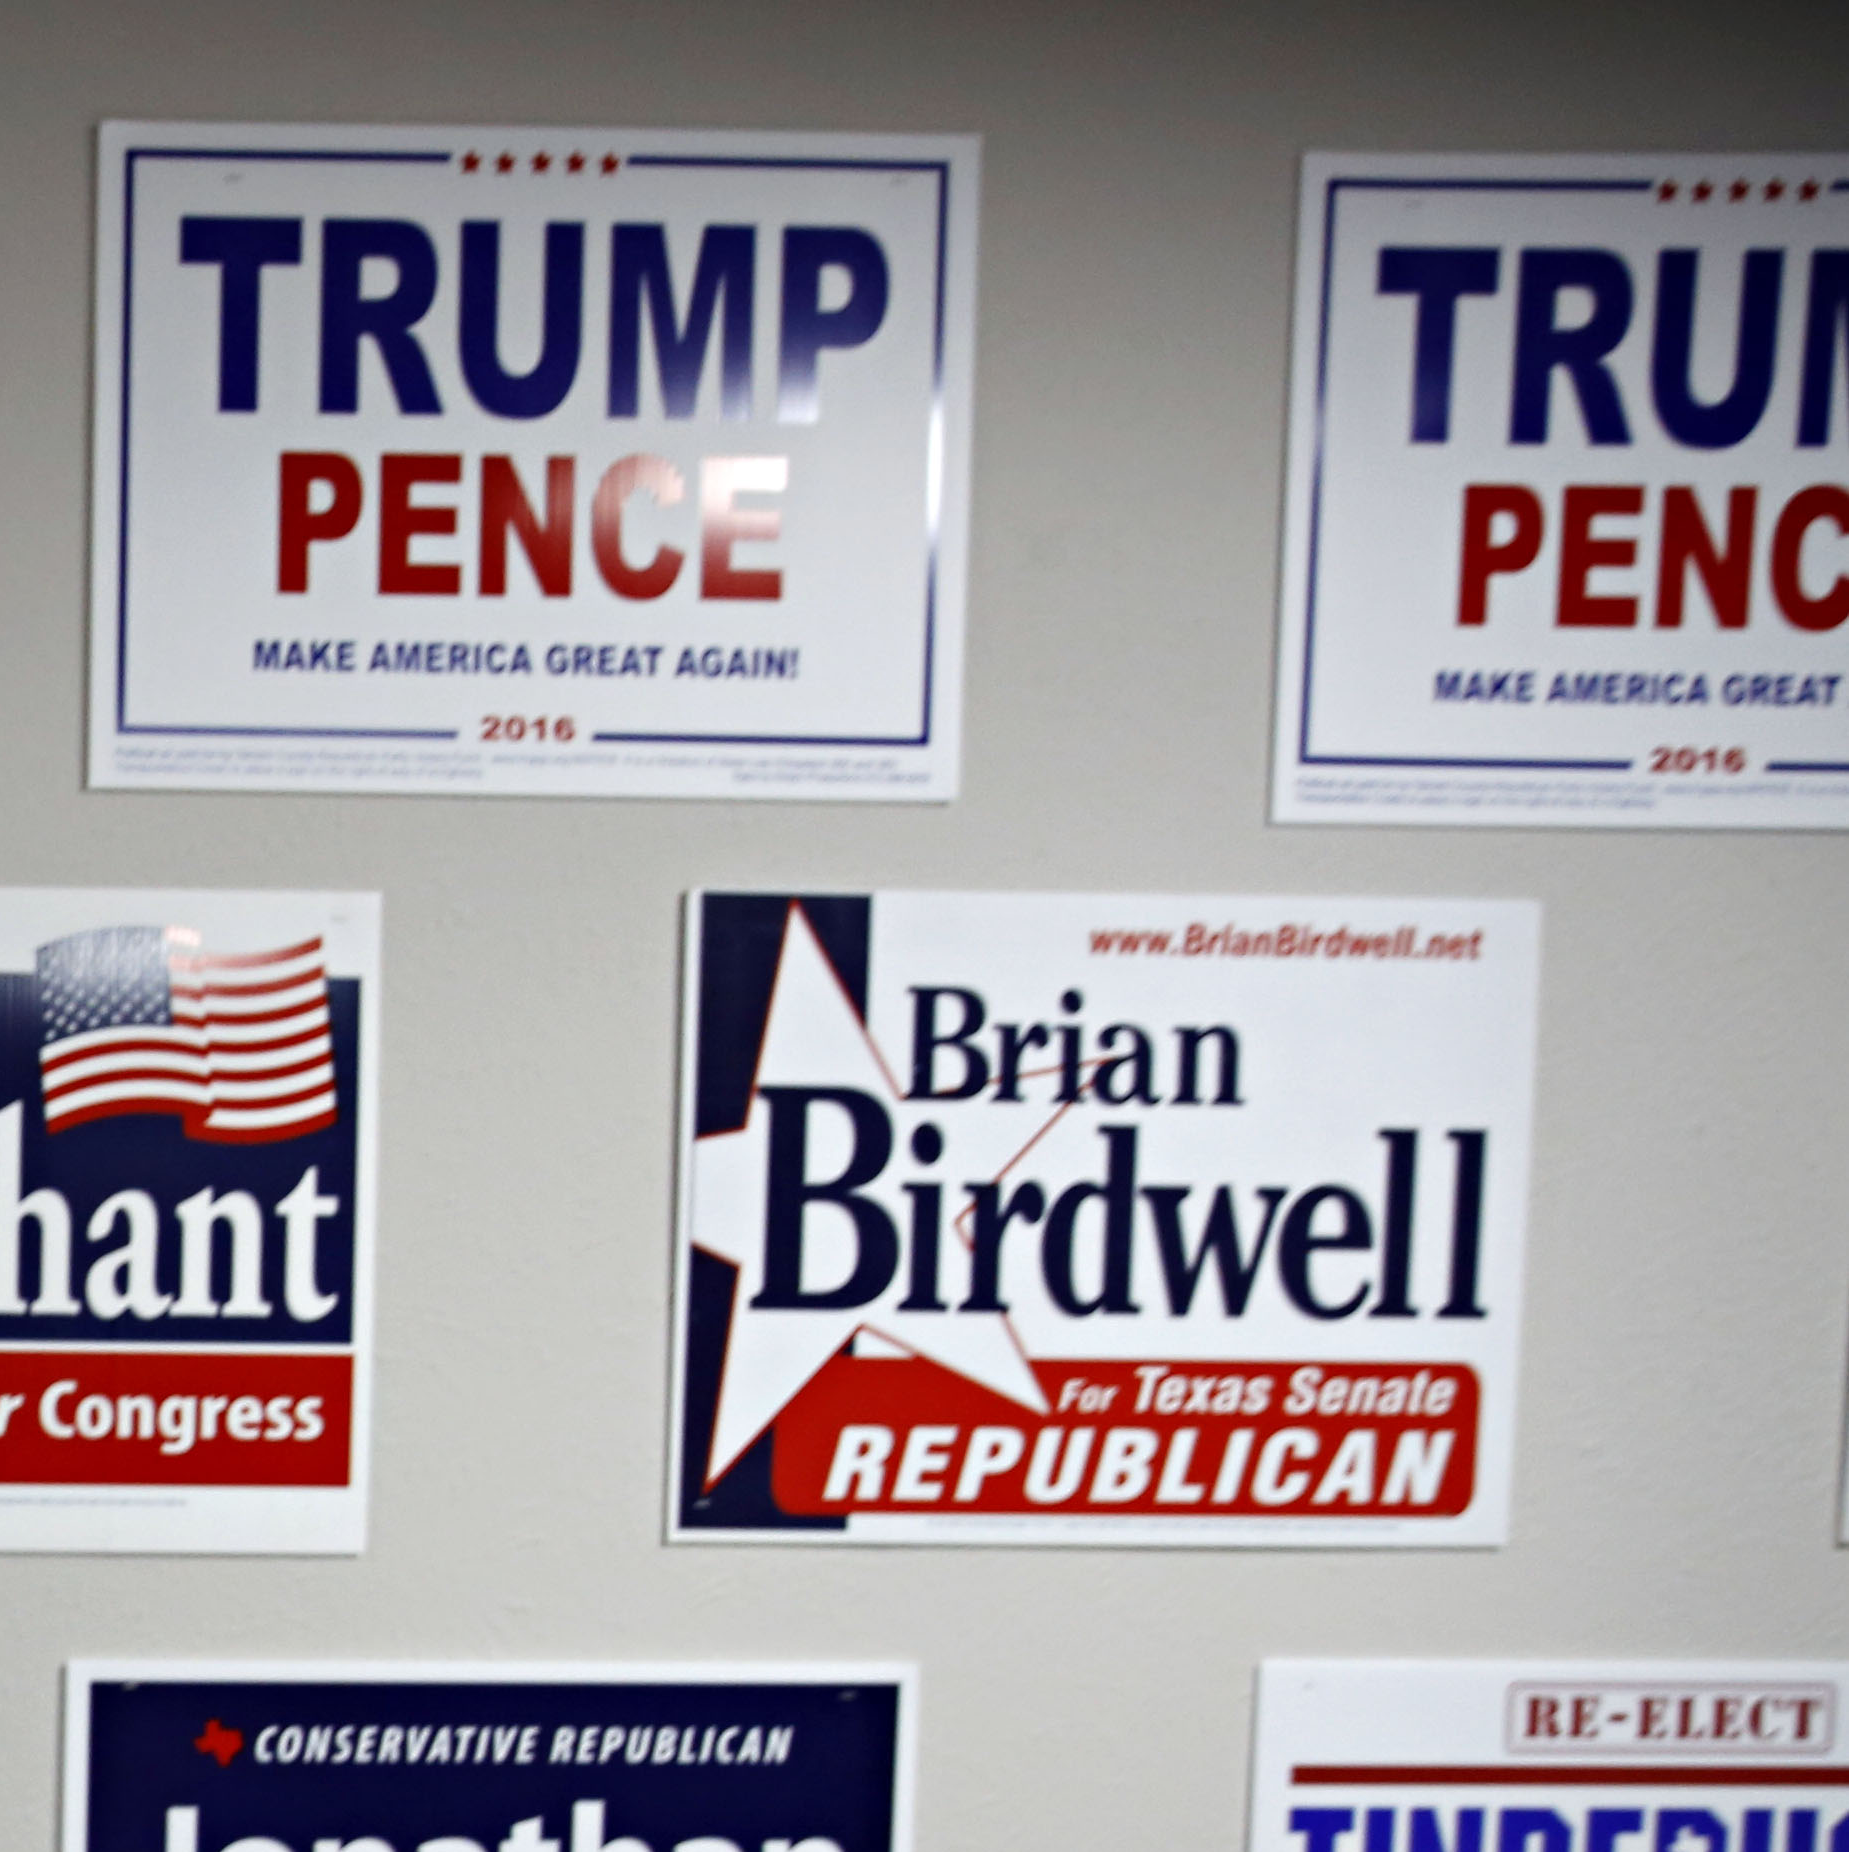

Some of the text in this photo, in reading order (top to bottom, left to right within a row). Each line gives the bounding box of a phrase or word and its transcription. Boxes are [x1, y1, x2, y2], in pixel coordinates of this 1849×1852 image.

[179, 216, 890, 423] TRUMP
[276, 451, 789, 602] PENCE
[254, 640, 798, 679] MAKE AMERICA GREAT AGAIN!
[1435, 671, 1838, 706] MAKE AMERICA GREAT
[480, 715, 574, 742] 2016
[1649, 748, 1746, 773] 2016
[1088, 923, 1483, 961] www.BrianBirdwell.net
[908, 987, 1243, 1107] Brian
[750, 1087, 1487, 1323] Birdwell
[1133, 1367, 1271, 1414] Texas
[1284, 1367, 1457, 1414] Senate
[39, 1380, 323, 1454] Congress
[823, 1426, 1451, 1508] REPUBLICAN
[1525, 1698, 1822, 1739] RE-ELECT
[254, 1723, 793, 1765] CONSERVATIVE REPUBLICAN
